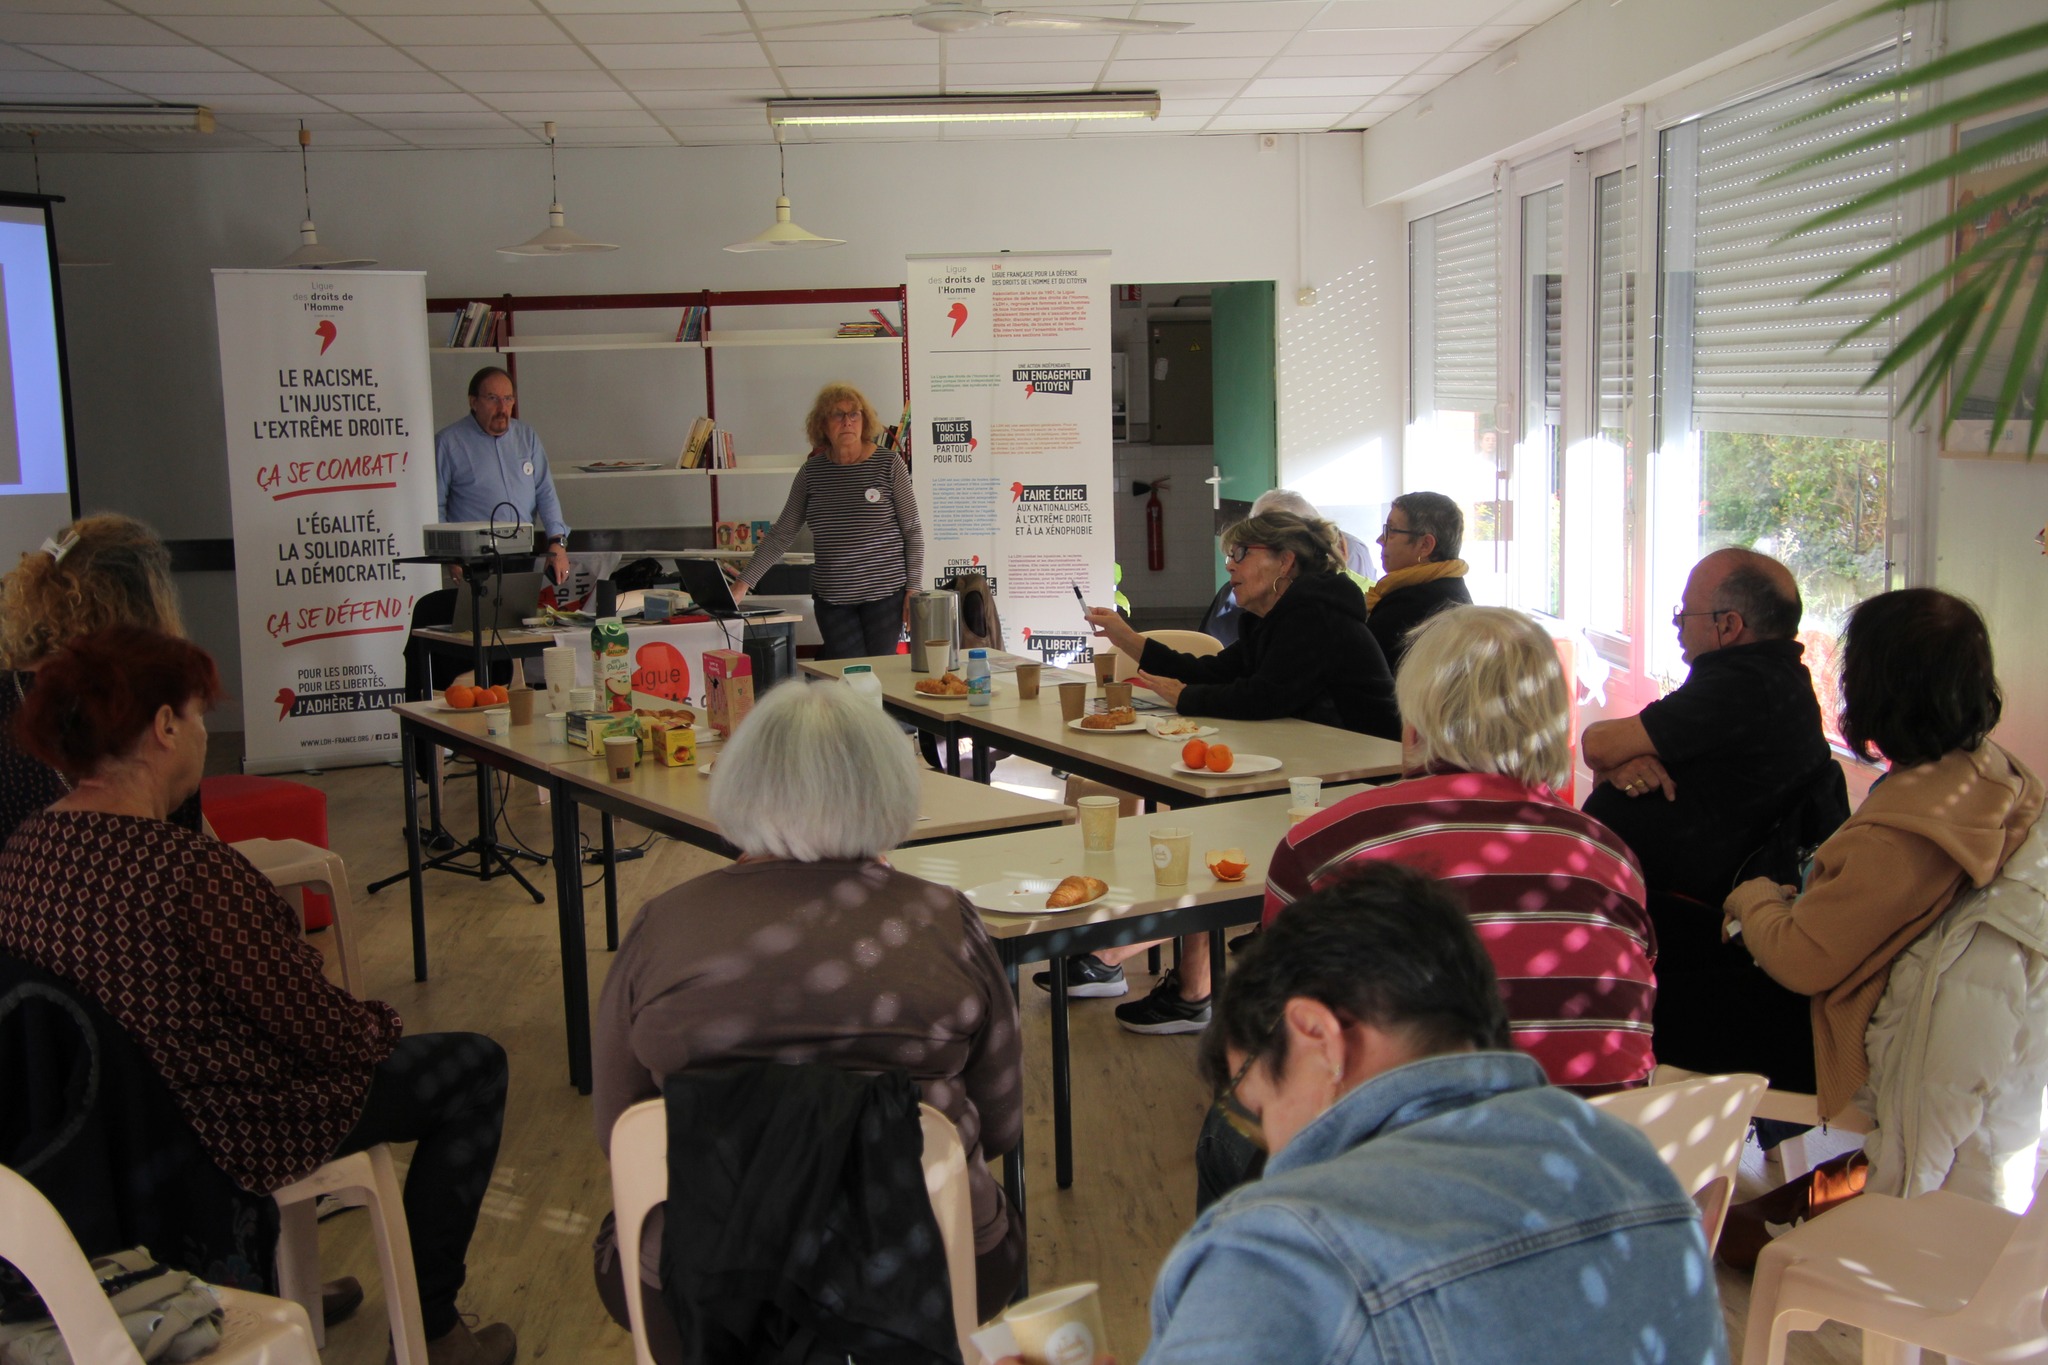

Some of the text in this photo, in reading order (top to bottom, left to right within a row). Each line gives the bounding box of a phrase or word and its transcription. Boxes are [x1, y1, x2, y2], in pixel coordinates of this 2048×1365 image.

[312, 282, 334, 291] Ligue
[279, 369, 378, 388] LE RACISME,
[1017, 370, 1087, 381] UN ENGAGEMENT
[1035, 382, 1070, 391] CITOYEN
[280, 394, 381, 412] L'INJUSTICE,
[254, 416, 409, 438] L'EXTRÊME DROITE,
[940, 433, 965, 442] DROITS
[257, 466, 282, 491] ÇA
[288, 461, 313, 483] SE
[317, 453, 399, 481] COMBAT
[1024, 487, 1083, 500] FAIRE ÉCHEC
[1033, 504, 1090, 512] NATIONALISMES,
[297, 510, 380, 534] L'ÉGALITÉ,
[1016, 513, 1092, 523] À L'EXTRÊME DROITE
[1016, 525, 1092, 535] ET À LA XÉNOPHOBIE
[279, 534, 400, 560] LA SOLIDARITÉ,
[276, 562, 406, 586] LA DÉMOCRATIE,
[267, 612, 290, 638] ÇA
[297, 608, 323, 629] SE
[326, 597, 401, 626] DÉFEND
[1032, 637, 1082, 651] LA LIBERTÉ
[298, 665, 376, 679] POUR LES DROITS,
[632, 669, 680, 690] igue
[299, 675, 386, 692] POUR LES LIBERTÉS,
[296, 694, 354, 714] J'ADHÈRE
[358, 693, 367, 709] À
[370, 695, 384, 708] LA
[300, 735, 369, 747] WWW.LDH-FRANCE.ORG
